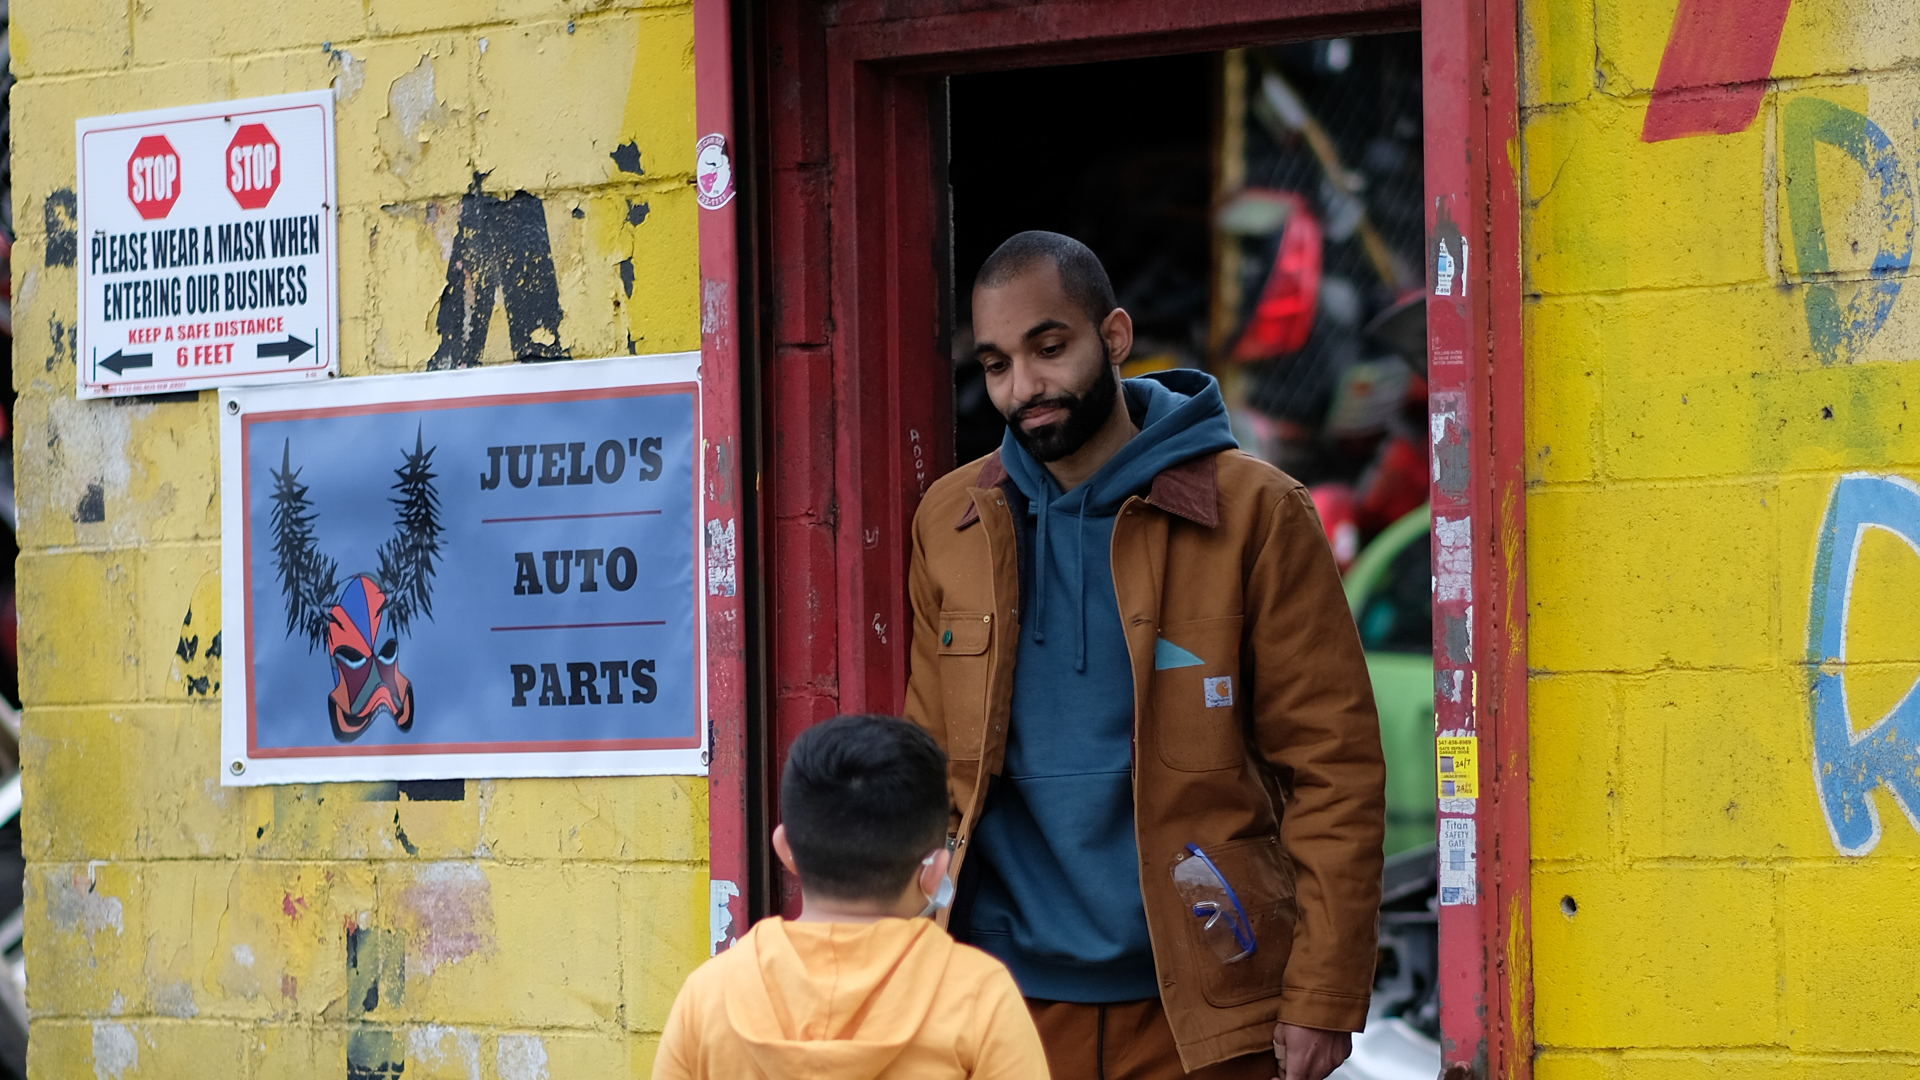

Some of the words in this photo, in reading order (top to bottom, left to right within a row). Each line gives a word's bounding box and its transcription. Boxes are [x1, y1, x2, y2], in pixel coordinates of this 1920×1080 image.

[132, 154, 177, 203] STOP
[230, 143, 277, 193] STOP
[91, 231, 147, 275] PLEASE
[152, 227, 199, 270] WEAR
[203, 225, 214, 265] A
[218, 220, 266, 263] MASK
[270, 214, 319, 258] WHEN
[104, 276, 181, 322] ENTERING
[186, 274, 220, 317] OUR
[225, 264, 307, 312] BUSINESS
[128, 327, 161, 345] KEEP
[165, 325, 174, 341] A
[177, 322, 210, 341] SAFE
[214, 316, 284, 338] DISTANCE
[177, 346, 188, 367] 6
[194, 343, 235, 366] FEET
[480, 437, 663, 491] JUELO'S
[514, 546, 638, 595] AUTO
[510, 659, 658, 707] PARTS
[1455, 758, 1471, 769] 24/7
[1445, 831, 1469, 839] SAFETY
[1446, 821, 1468, 830] Titan
[1448, 840, 1466, 848] GATE
